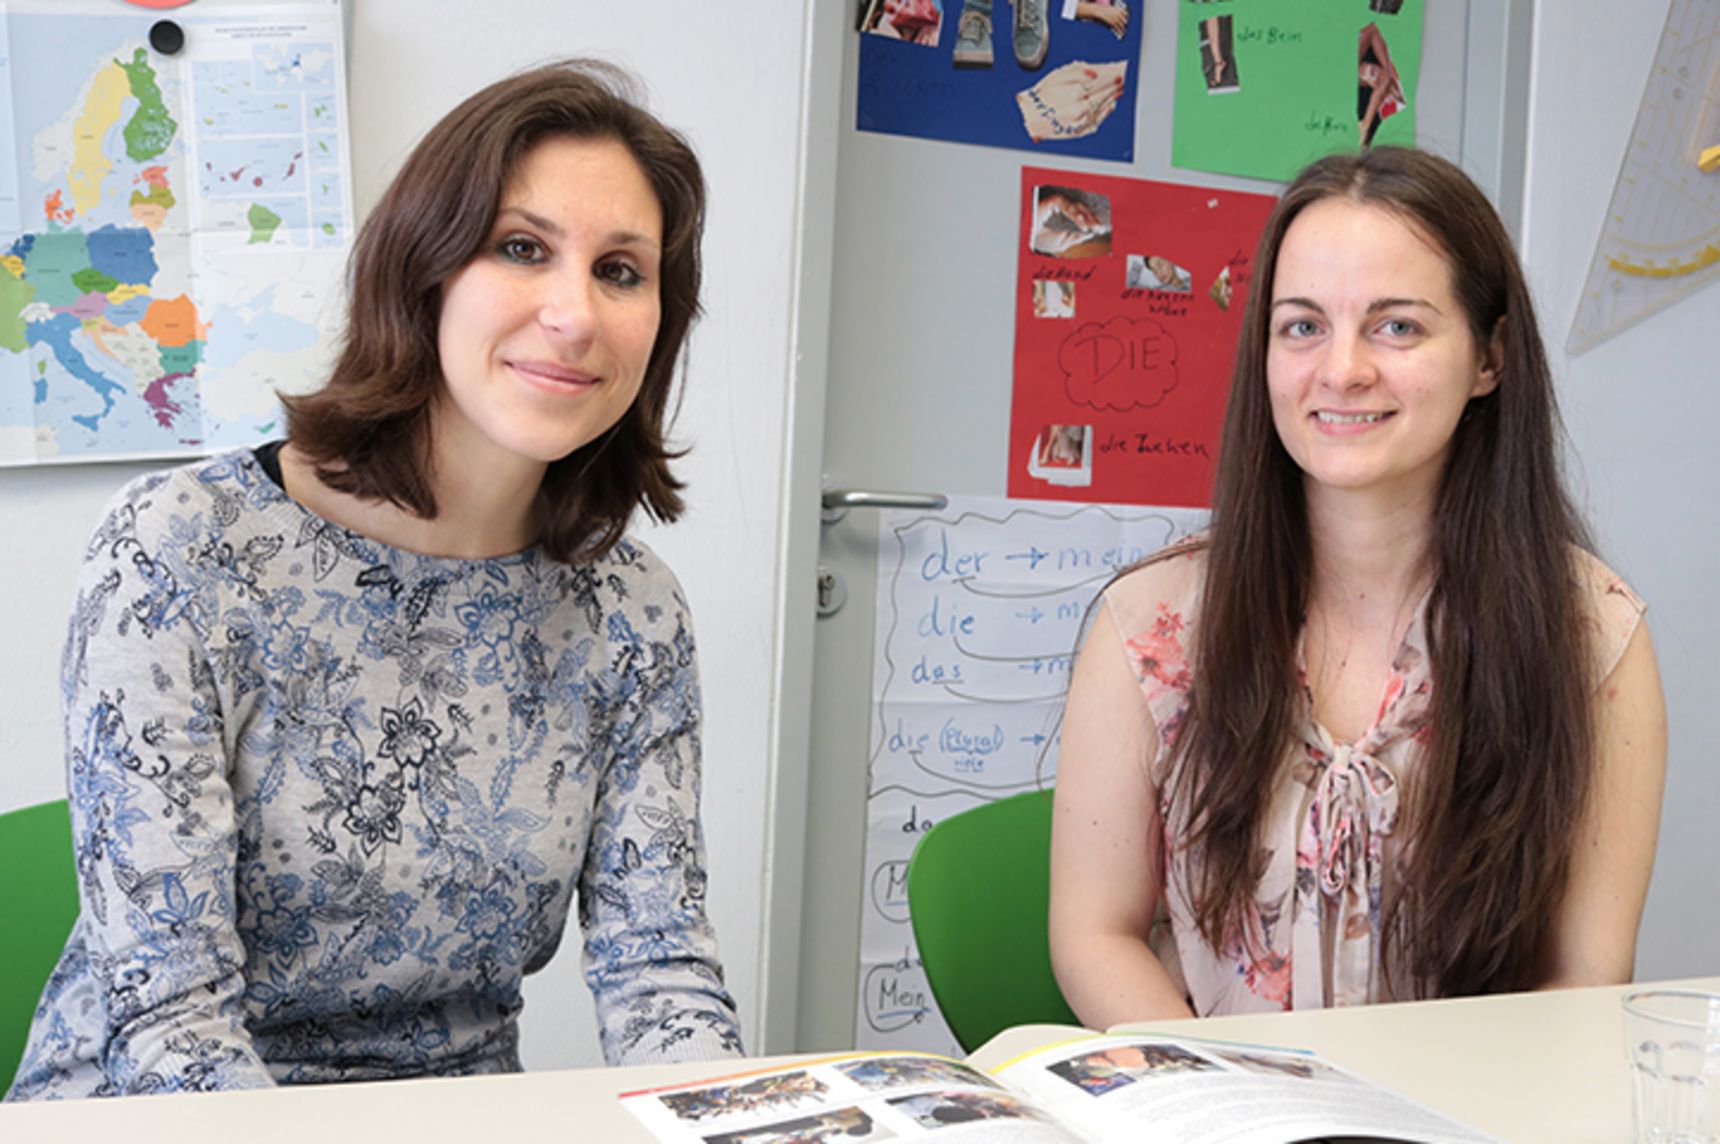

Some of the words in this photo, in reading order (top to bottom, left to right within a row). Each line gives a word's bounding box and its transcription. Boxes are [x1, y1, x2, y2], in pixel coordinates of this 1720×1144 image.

[1073, 335, 1161, 385] DIE
[1099, 432, 1128, 454] die
[921, 528, 990, 581] der
[1056, 546, 1142, 571] mein
[918, 596, 975, 637] die
[911, 655, 962, 684] das
[887, 717, 930, 752] die
[902, 804, 933, 832] da
